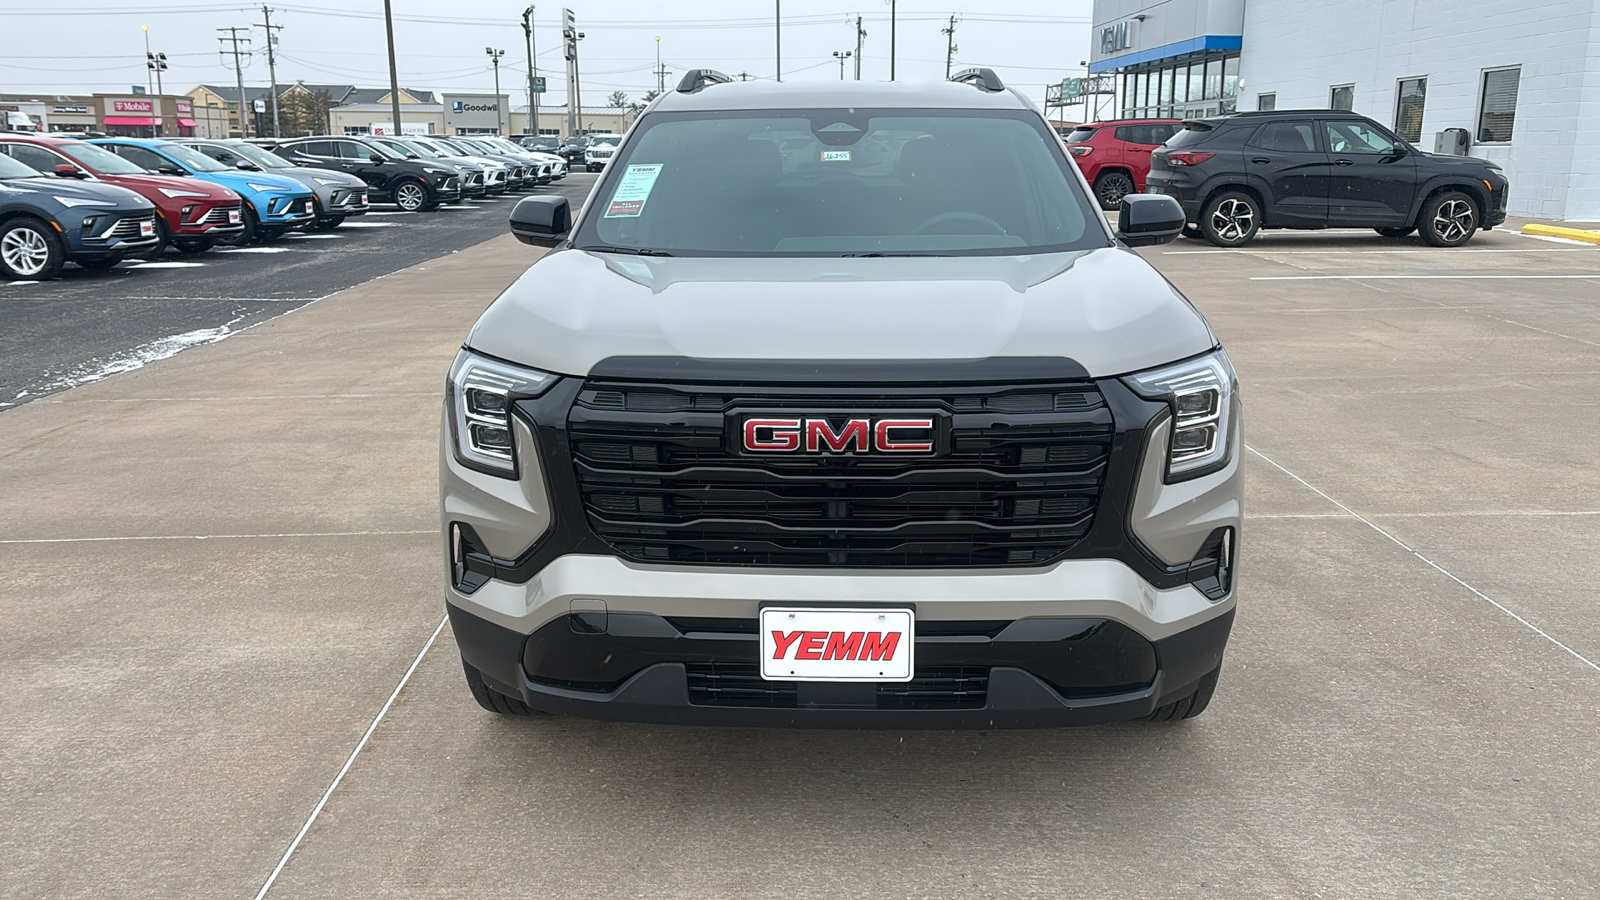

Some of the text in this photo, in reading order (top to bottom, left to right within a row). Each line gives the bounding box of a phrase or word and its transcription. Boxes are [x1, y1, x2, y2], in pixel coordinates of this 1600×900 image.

[463, 103, 499, 111] Goodwil
[743, 418, 933, 452] GMC
[771, 630, 902, 661] YEMM
